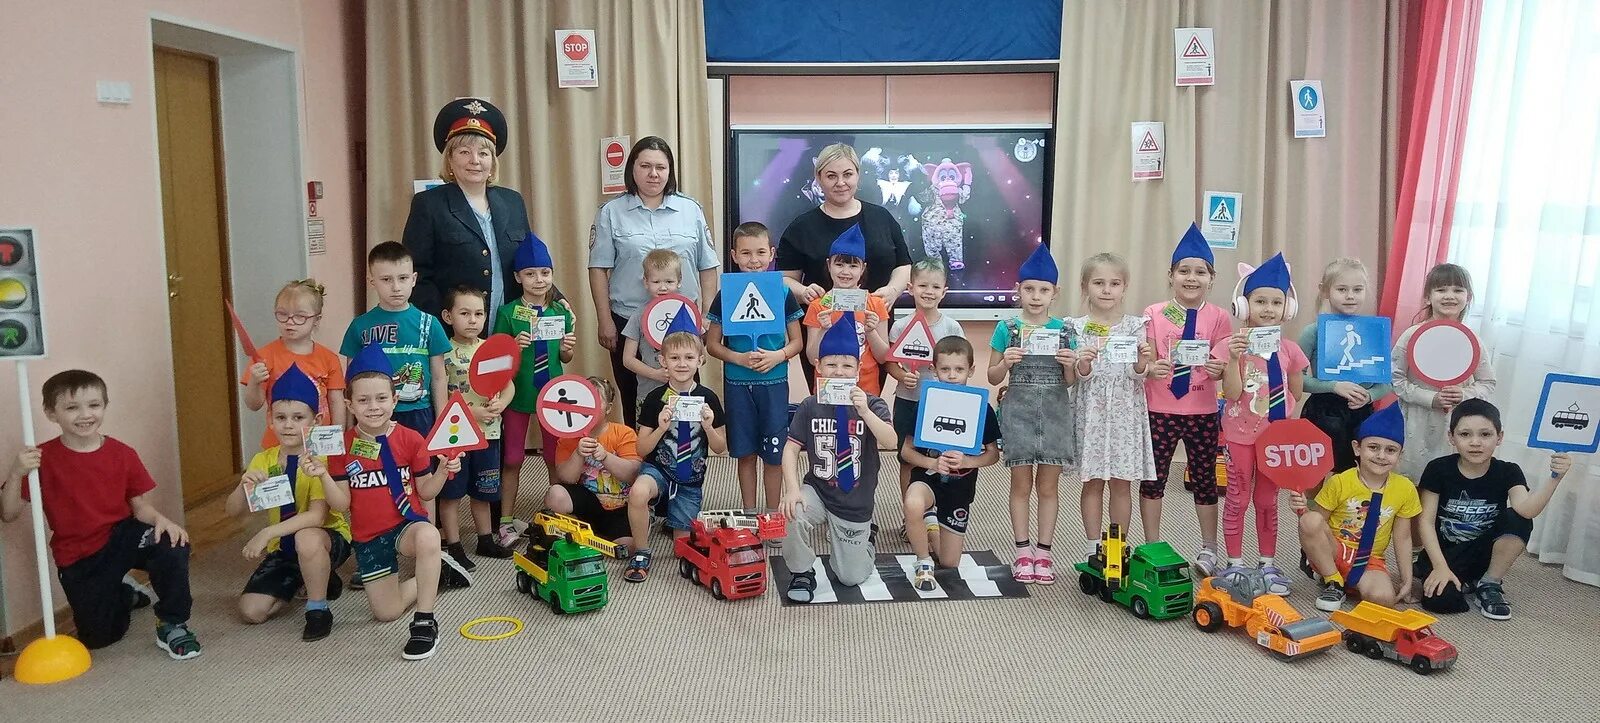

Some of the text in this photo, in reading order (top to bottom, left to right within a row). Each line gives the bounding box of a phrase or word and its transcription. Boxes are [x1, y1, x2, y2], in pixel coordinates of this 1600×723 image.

[565, 43, 588, 52] STOP
[360, 324, 399, 346] LIVE
[811, 418, 865, 435] CHICGO
[1265, 443, 1325, 468] STOP
[350, 466, 411, 488] HEAVN
[1446, 504, 1498, 514] SPEED
